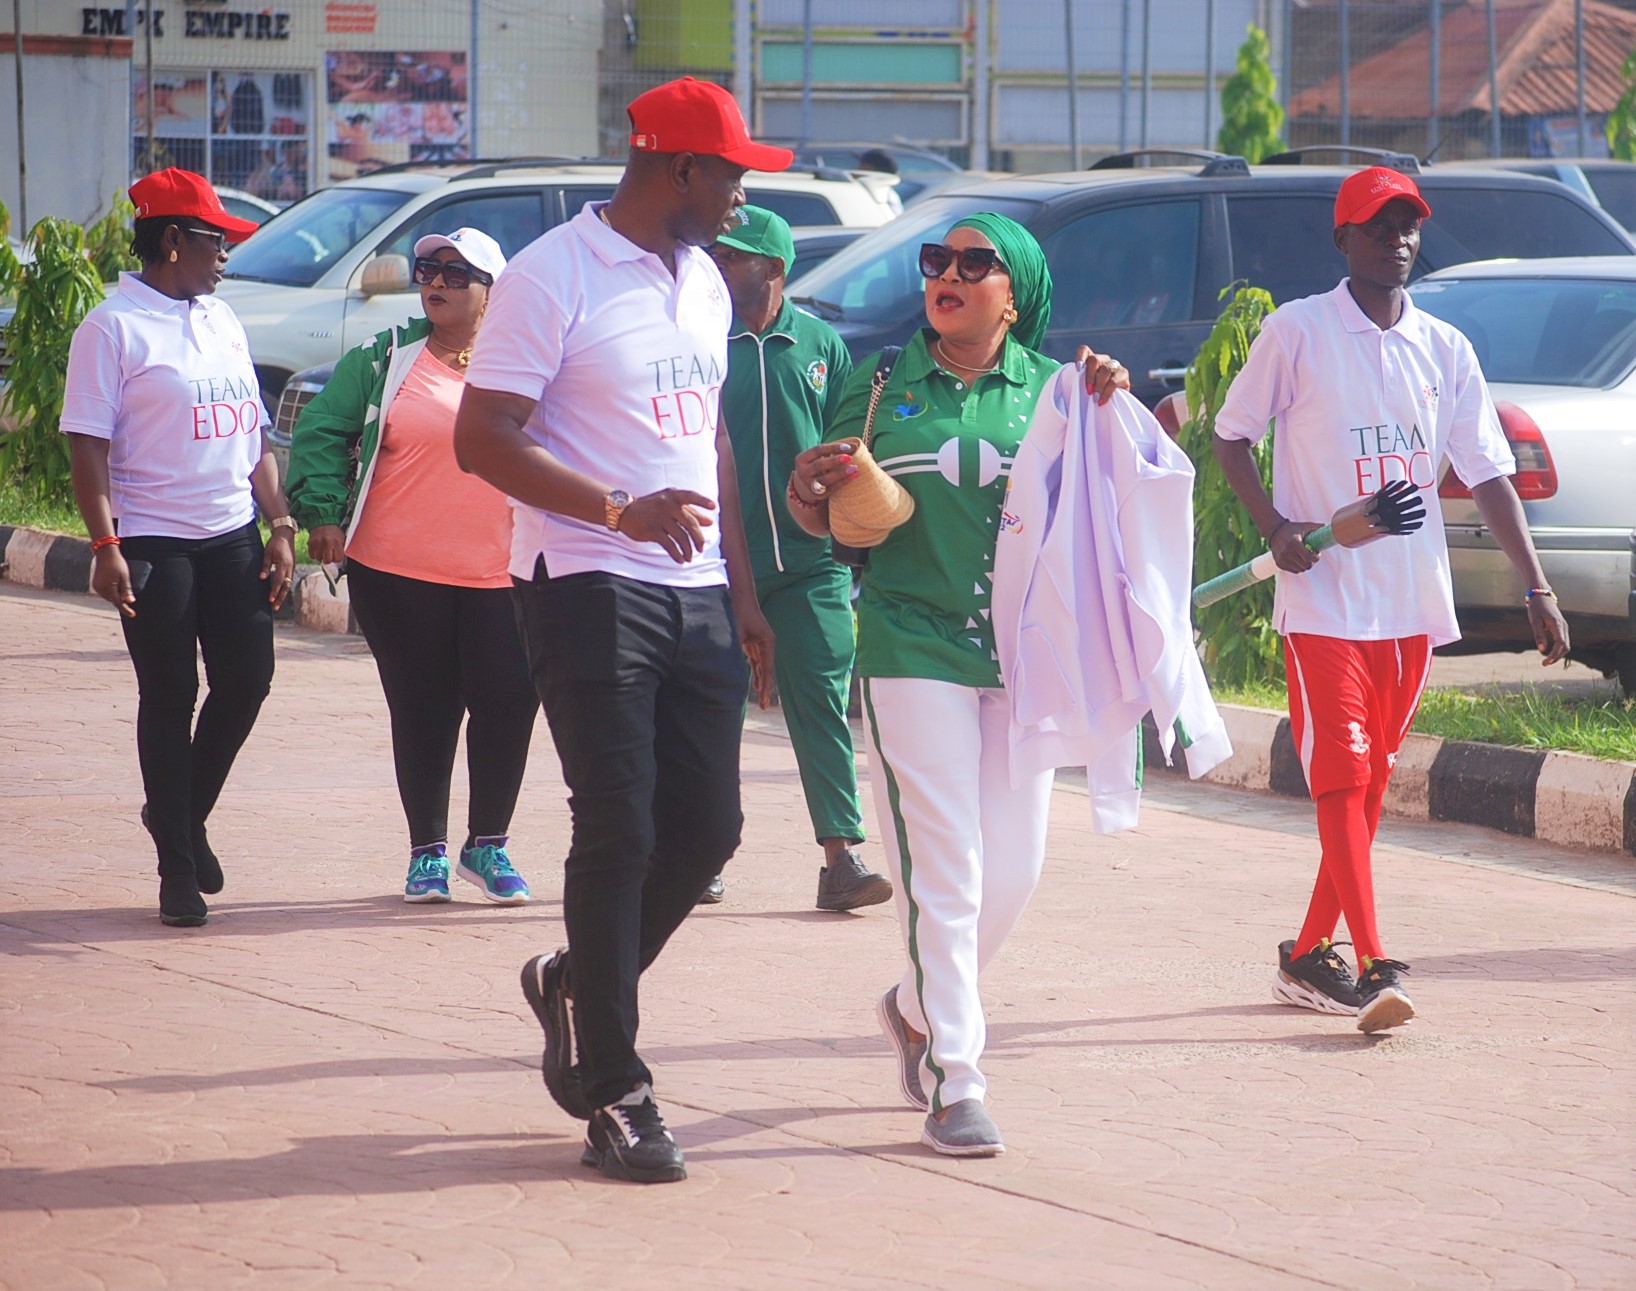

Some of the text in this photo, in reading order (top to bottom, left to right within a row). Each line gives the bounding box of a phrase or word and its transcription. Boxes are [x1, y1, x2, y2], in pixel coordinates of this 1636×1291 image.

[185, 10, 290, 40] EMPIRE
[188, 376, 258, 404] TEAM
[190, 400, 259, 441] EDO
